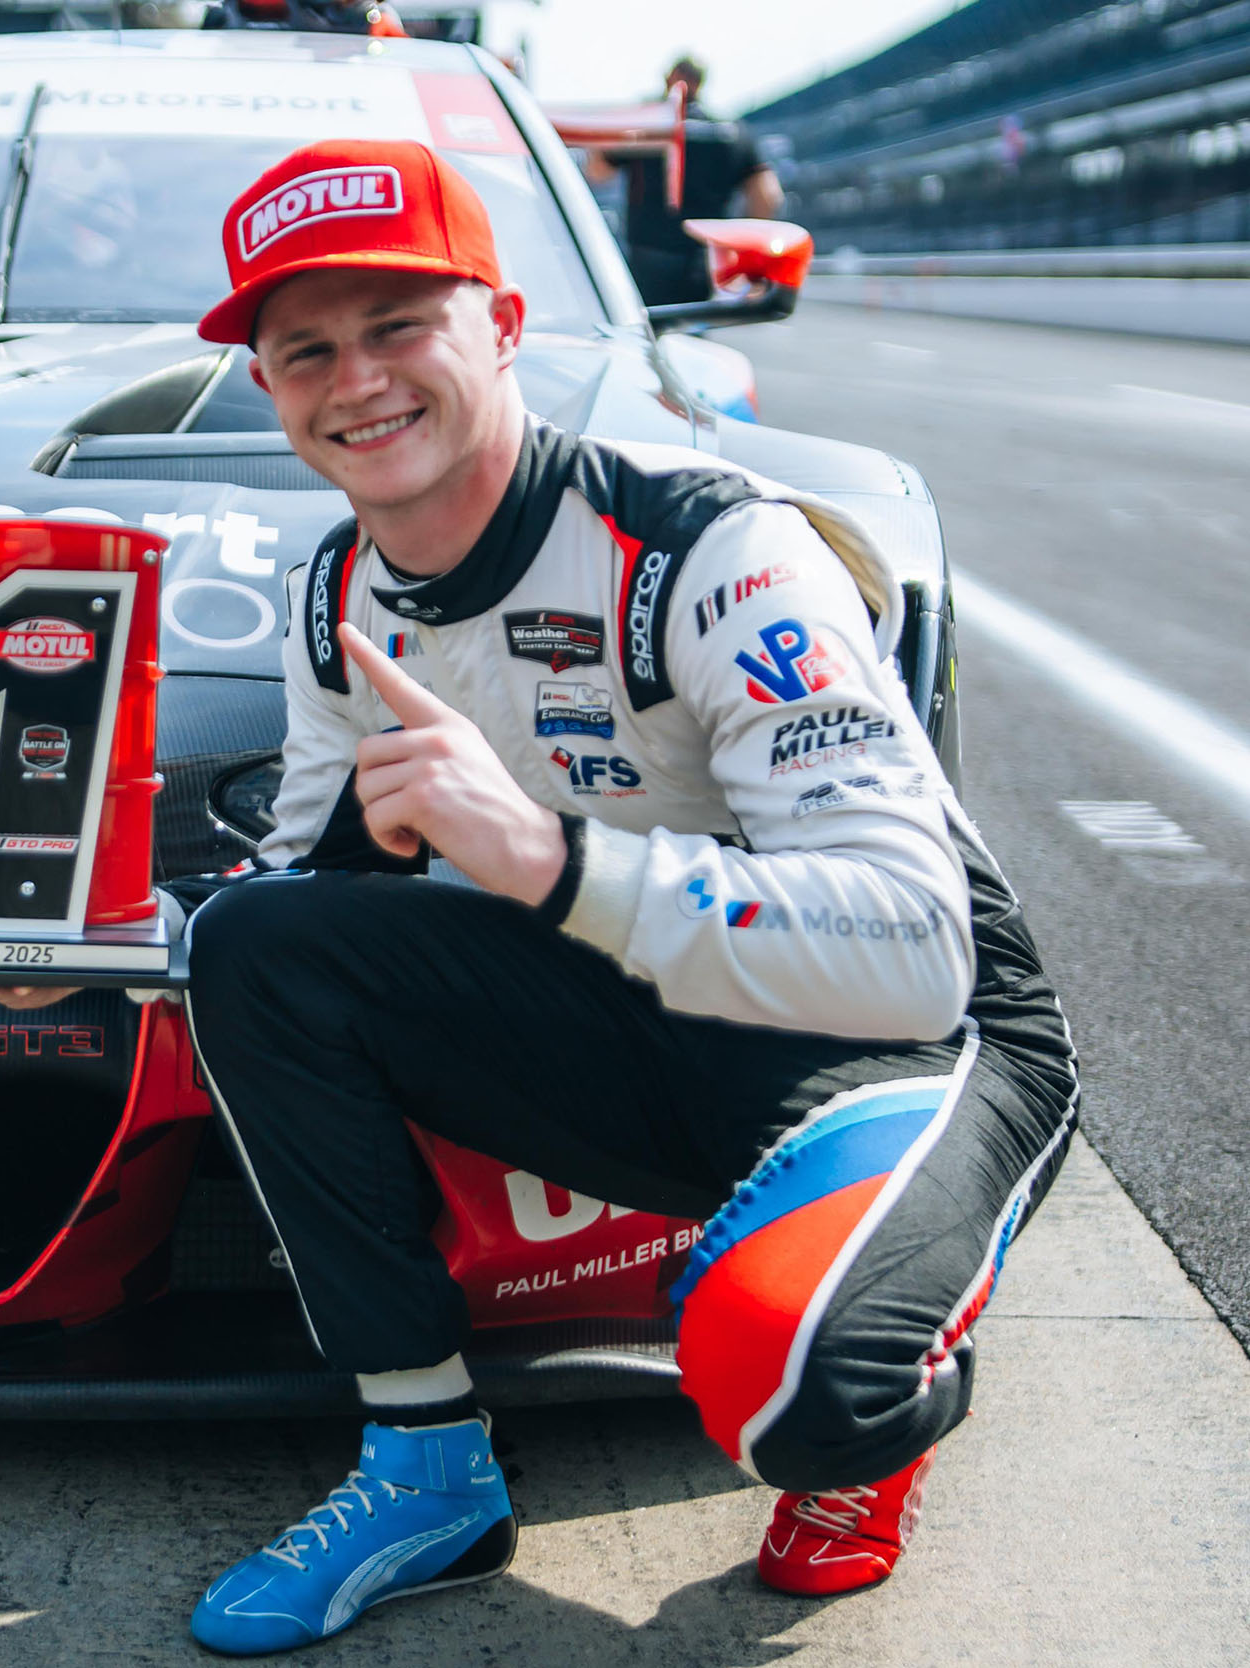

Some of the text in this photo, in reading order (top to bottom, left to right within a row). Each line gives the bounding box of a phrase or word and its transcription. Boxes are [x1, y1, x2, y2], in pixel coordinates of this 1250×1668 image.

[43, 87, 370, 112] Motorsport
[251, 175, 386, 246] MOTUL
[735, 563, 797, 604] IMS
[313, 548, 336, 663] sparco
[630, 551, 666, 681] sparco
[1, 634, 90, 656] MOTUL
[734, 618, 811, 703] VP
[772, 705, 870, 745] PAUL
[24, 741, 67, 750] BATTLE ON
[768, 742, 868, 780] RACING
[569, 755, 642, 788] IFS
[41, 840, 75, 849] PRO
[3, 945, 55, 964] 2025
[495, 1224, 706, 1300] PAUL MILLER BM
